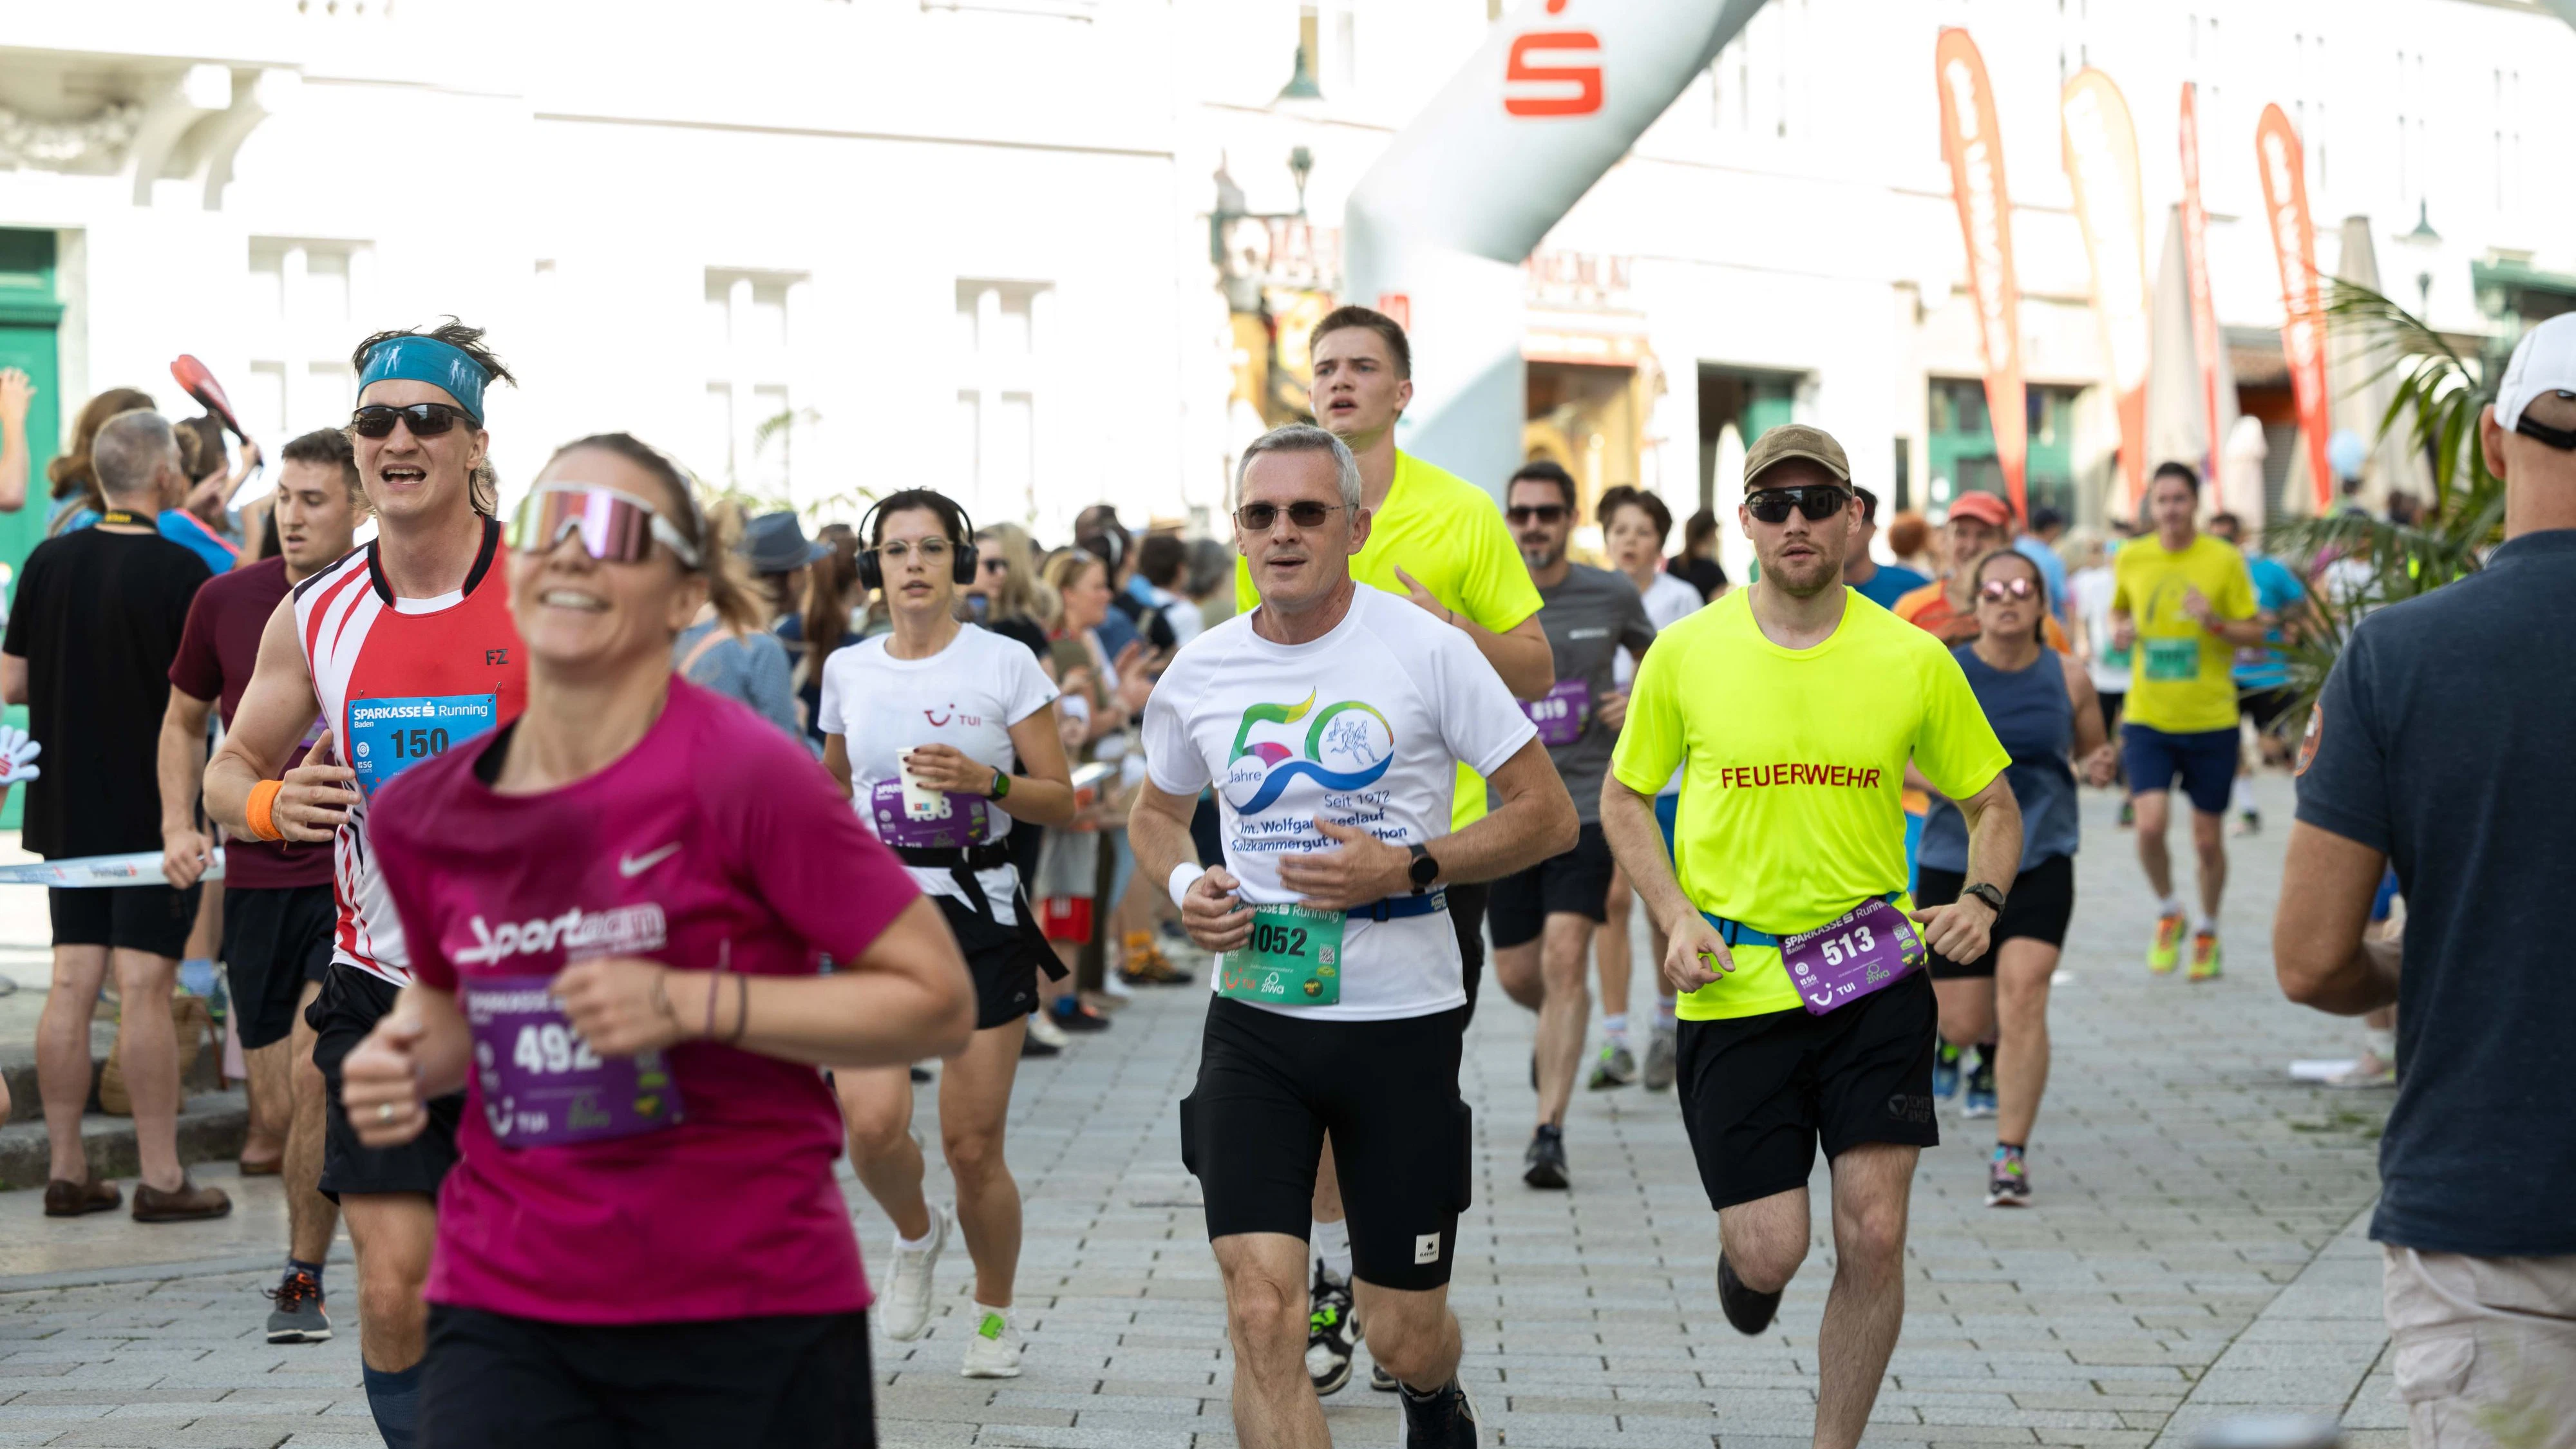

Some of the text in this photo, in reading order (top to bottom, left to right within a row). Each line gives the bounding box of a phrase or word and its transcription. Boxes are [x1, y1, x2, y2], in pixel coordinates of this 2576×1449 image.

[486, 649, 509, 665] FZ
[354, 706, 421, 720] SPARKASSE
[439, 704, 488, 717] Running
[959, 715, 981, 726] TUI
[391, 728, 450, 759] 150
[1227, 685, 1394, 815] 50
[1228, 769, 1262, 784] Jahre
[1721, 764, 1880, 789] FEUERWEHR
[1325, 790, 1390, 808] Seit 1972
[1240, 807, 1385, 835] Int. Wolfgaeelauf
[1231, 835, 1329, 852] Salzkammergut
[1785, 918, 1843, 948] SPARKASSE
[1855, 900, 1890, 919] Runni
[1248, 922, 1308, 957] 1052
[1821, 926, 1875, 966] 513
[1786, 942, 1806, 956] Baden
[1242, 978, 1256, 989] TUI
[1800, 974, 1817, 985] BSG
[1836, 981, 1856, 996] TUI
